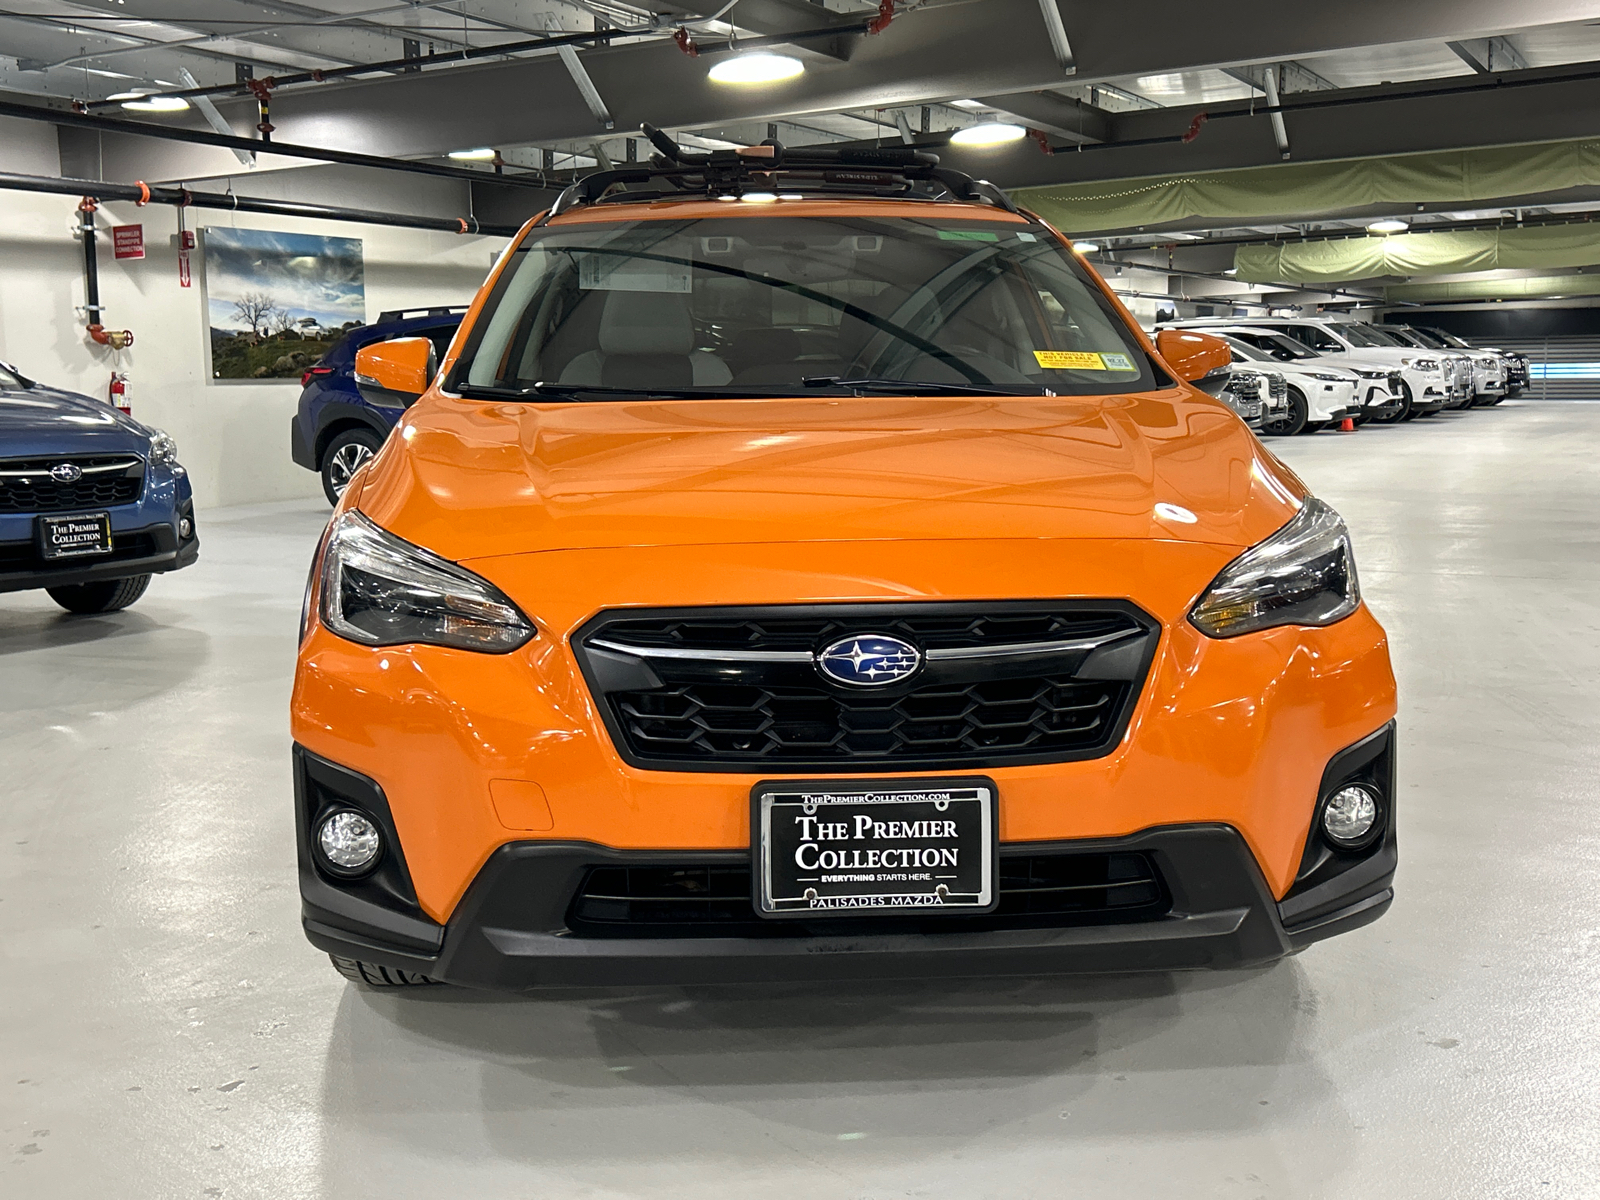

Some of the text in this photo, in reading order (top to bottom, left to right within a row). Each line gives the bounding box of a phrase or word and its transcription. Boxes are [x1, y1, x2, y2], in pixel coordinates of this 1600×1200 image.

[51, 523, 100, 534] THE PREMIER
[52, 533, 100, 544] COLLECTION
[795, 814, 959, 841] THE PREMIER
[794, 842, 959, 870] COLLECTION
[821, 872, 933, 883] EVERYTHING STARTS HERE.
[809, 894, 944, 909] PALISADES MAZDA
